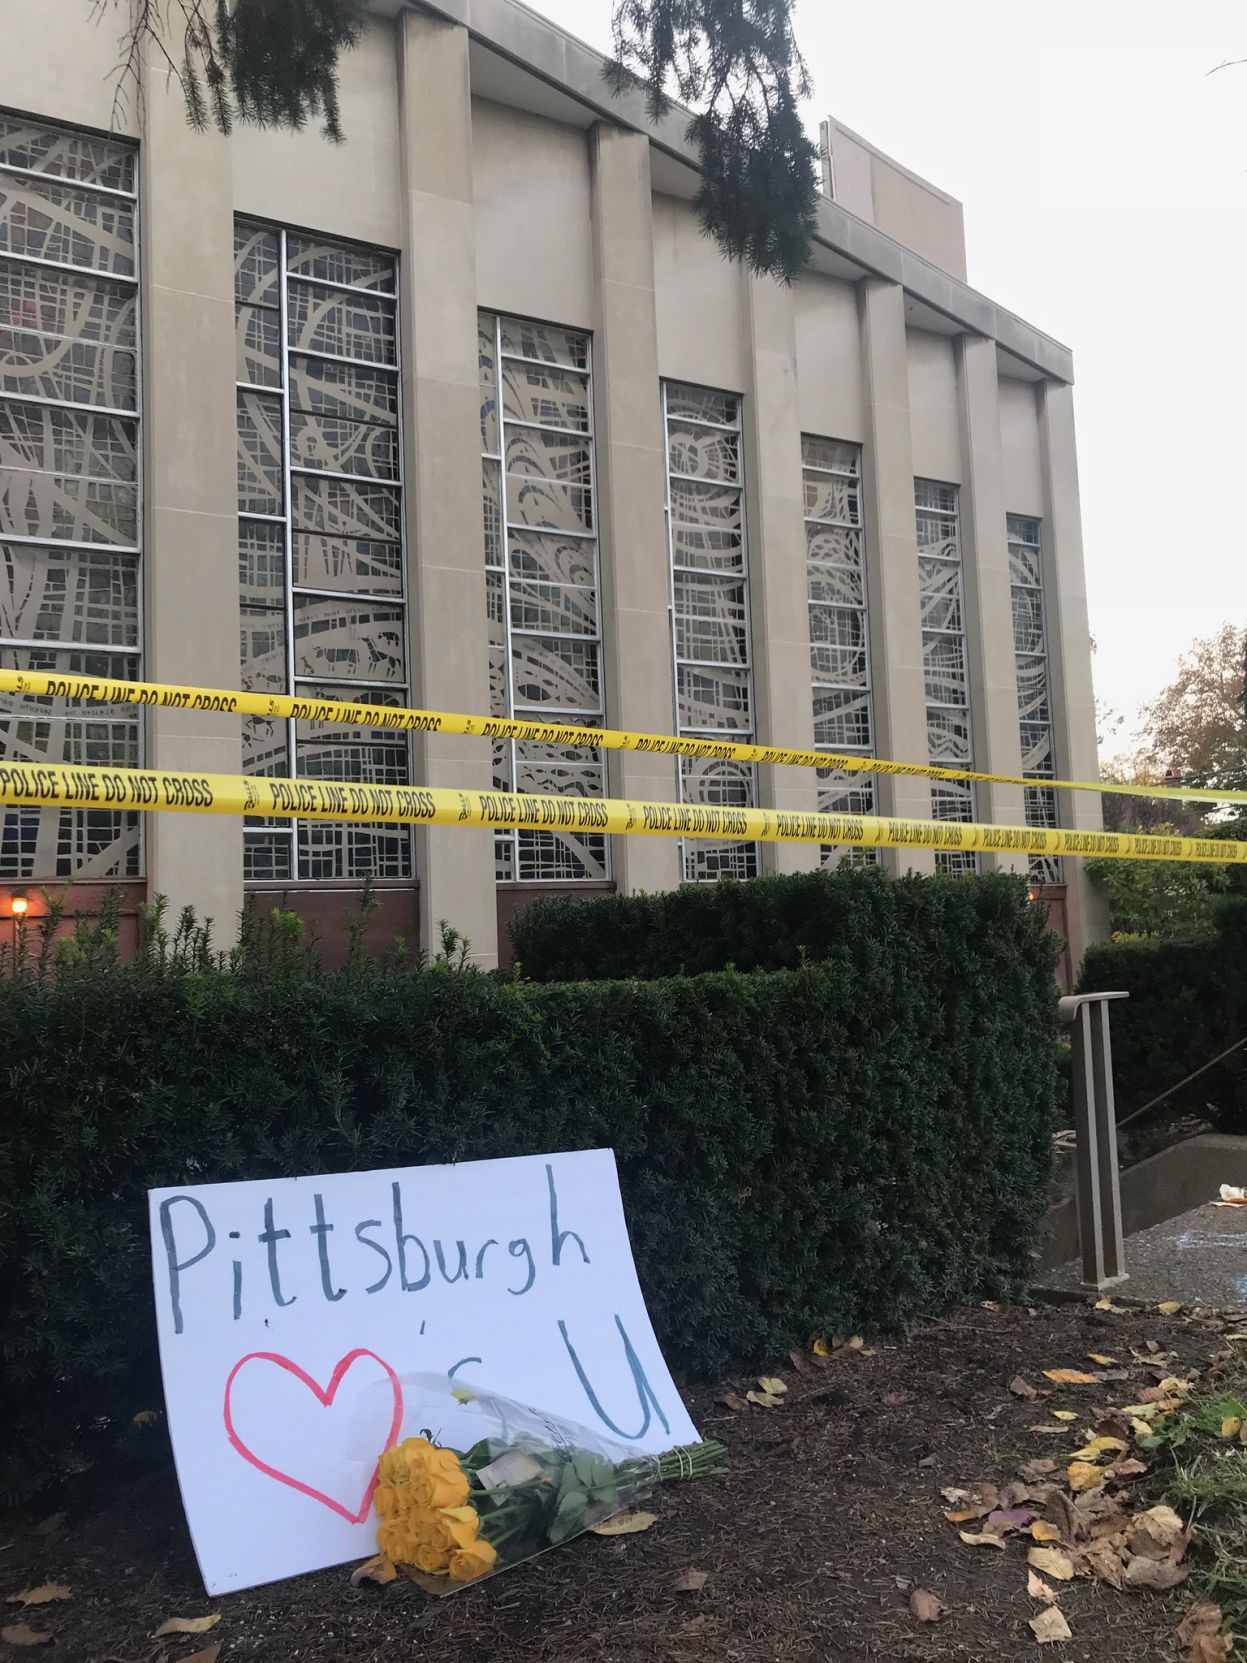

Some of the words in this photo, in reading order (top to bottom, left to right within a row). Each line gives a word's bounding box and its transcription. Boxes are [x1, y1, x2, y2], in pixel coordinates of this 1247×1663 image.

[0, 768, 59, 799] POLICE
[62, 771, 100, 801] LINE
[102, 774, 126, 803] DO
[128, 775, 159, 804] NOT
[162, 776, 213, 807] CROSS
[269, 783, 317, 812] POLICE
[318, 786, 348, 814] LINE
[348, 788, 369, 815] DO
[370, 790, 393, 816] NOT
[395, 790, 436, 819] CROSS
[479, 795, 516, 822] POLICE
[516, 798, 540, 824] LINE
[541, 800, 556, 825] DO
[556, 801, 575, 826] NOT
[577, 802, 608, 827] CROSS
[643, 805, 672, 830] POLICE
[673, 807, 692, 832] LINE
[693, 809, 705, 832] DO
[705, 810, 720, 833] NOT
[722, 811, 748, 835] CROSS
[776, 814, 801, 838] POLICE
[801, 816, 817, 838] LINE
[817, 817, 828, 839] DO
[828, 818, 842, 840] NOT
[842, 819, 864, 841] CROSS
[159, 1163, 590, 1334] Pittsburgh
[557, 1314, 670, 1440] U
